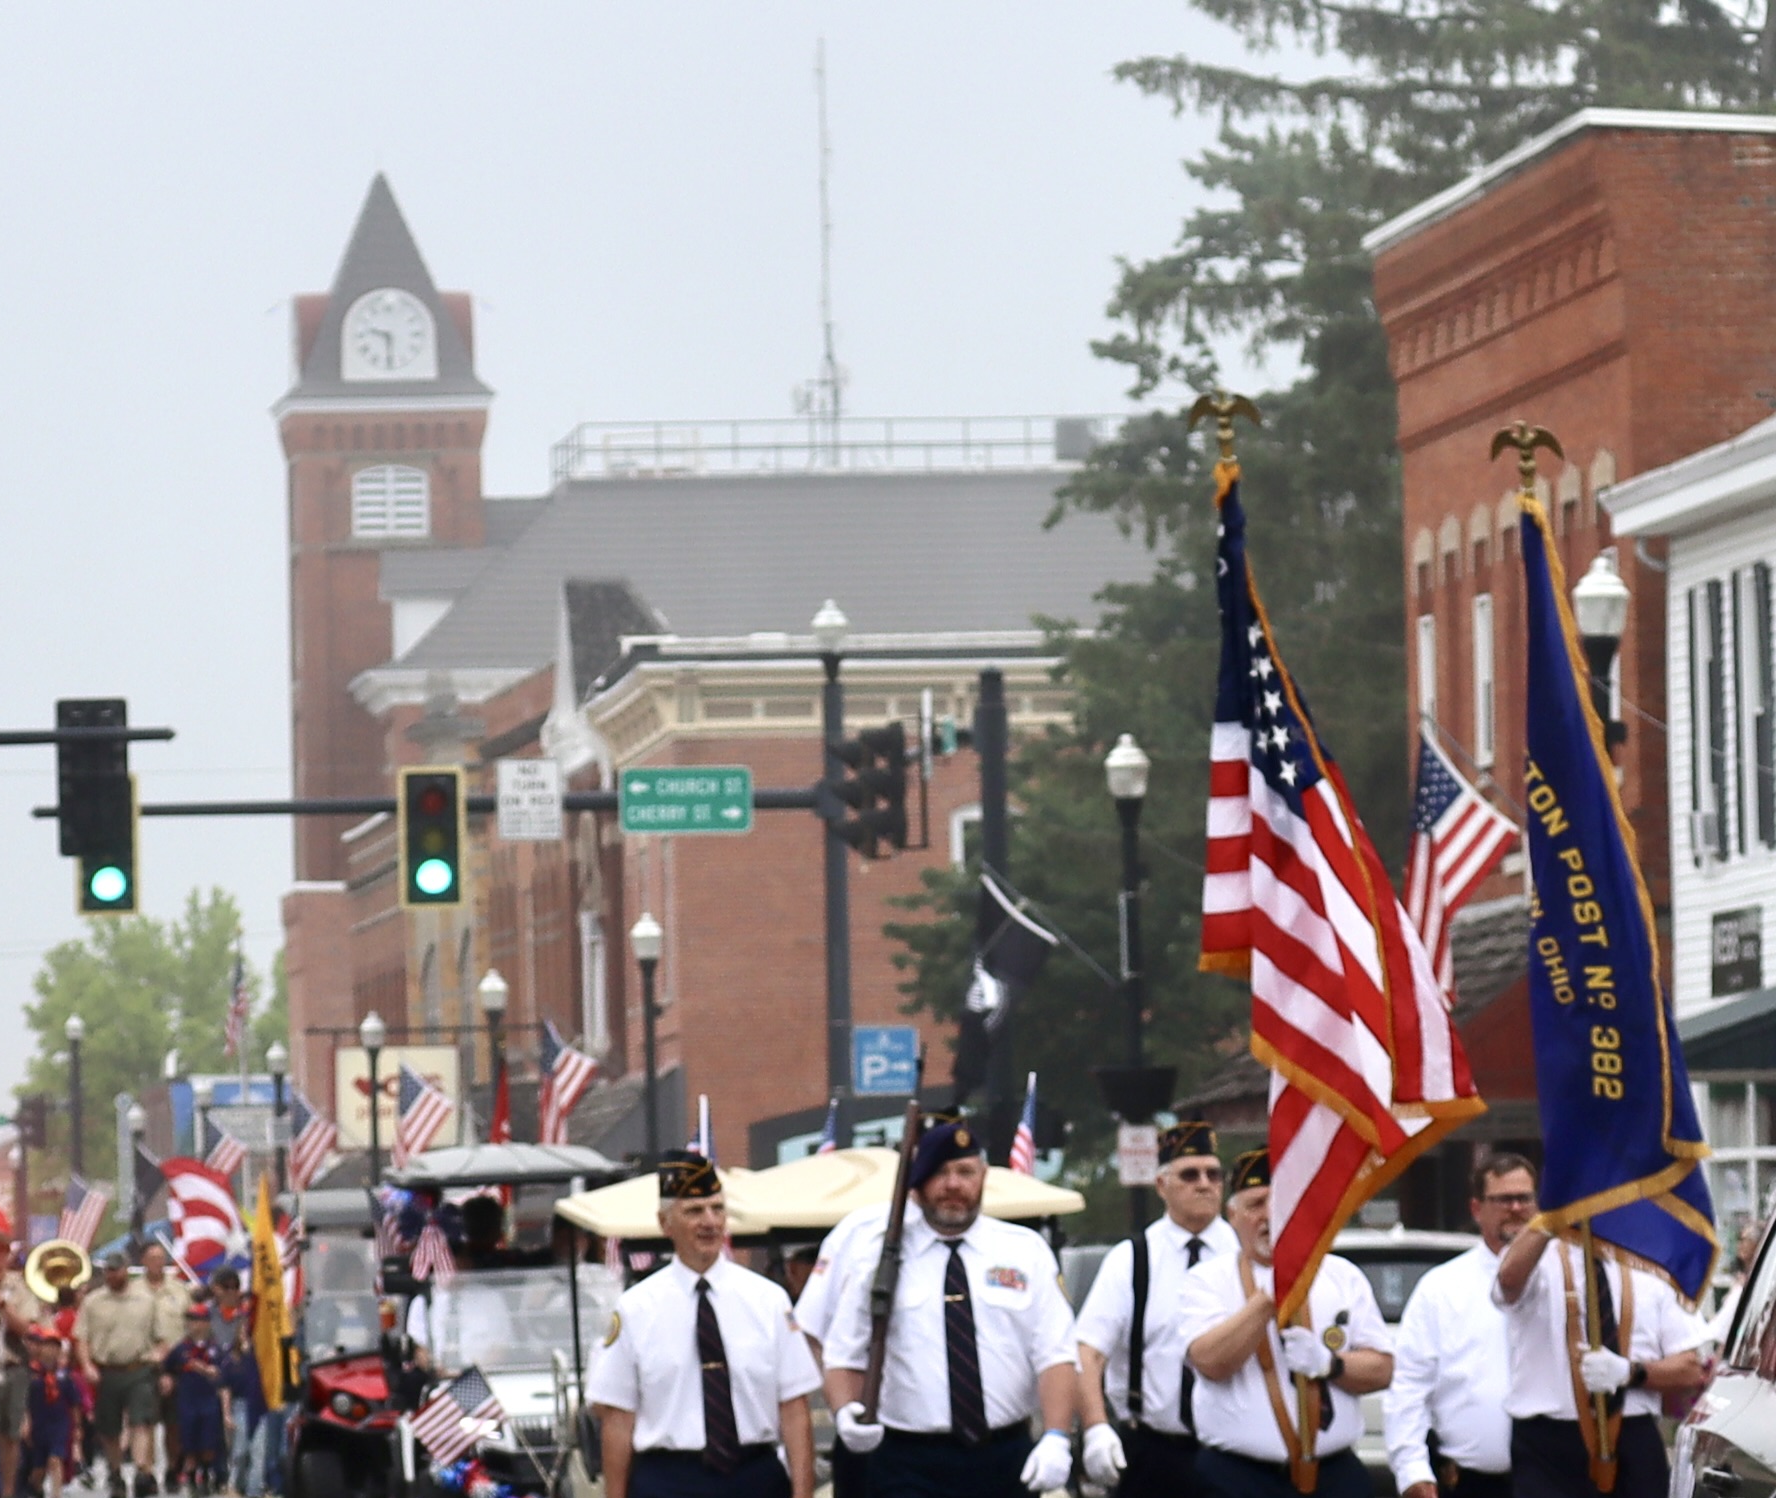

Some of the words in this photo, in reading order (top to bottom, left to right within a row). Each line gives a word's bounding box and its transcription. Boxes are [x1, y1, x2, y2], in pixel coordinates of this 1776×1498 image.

[655, 777, 720, 796] CHURCH
[627, 804, 686, 822] CHERRY
[1524, 758, 1570, 838] TON
[1558, 847, 1609, 948] POST
[1590, 1025, 1624, 1100] 382
[1536, 936, 1575, 1005] OHIO
